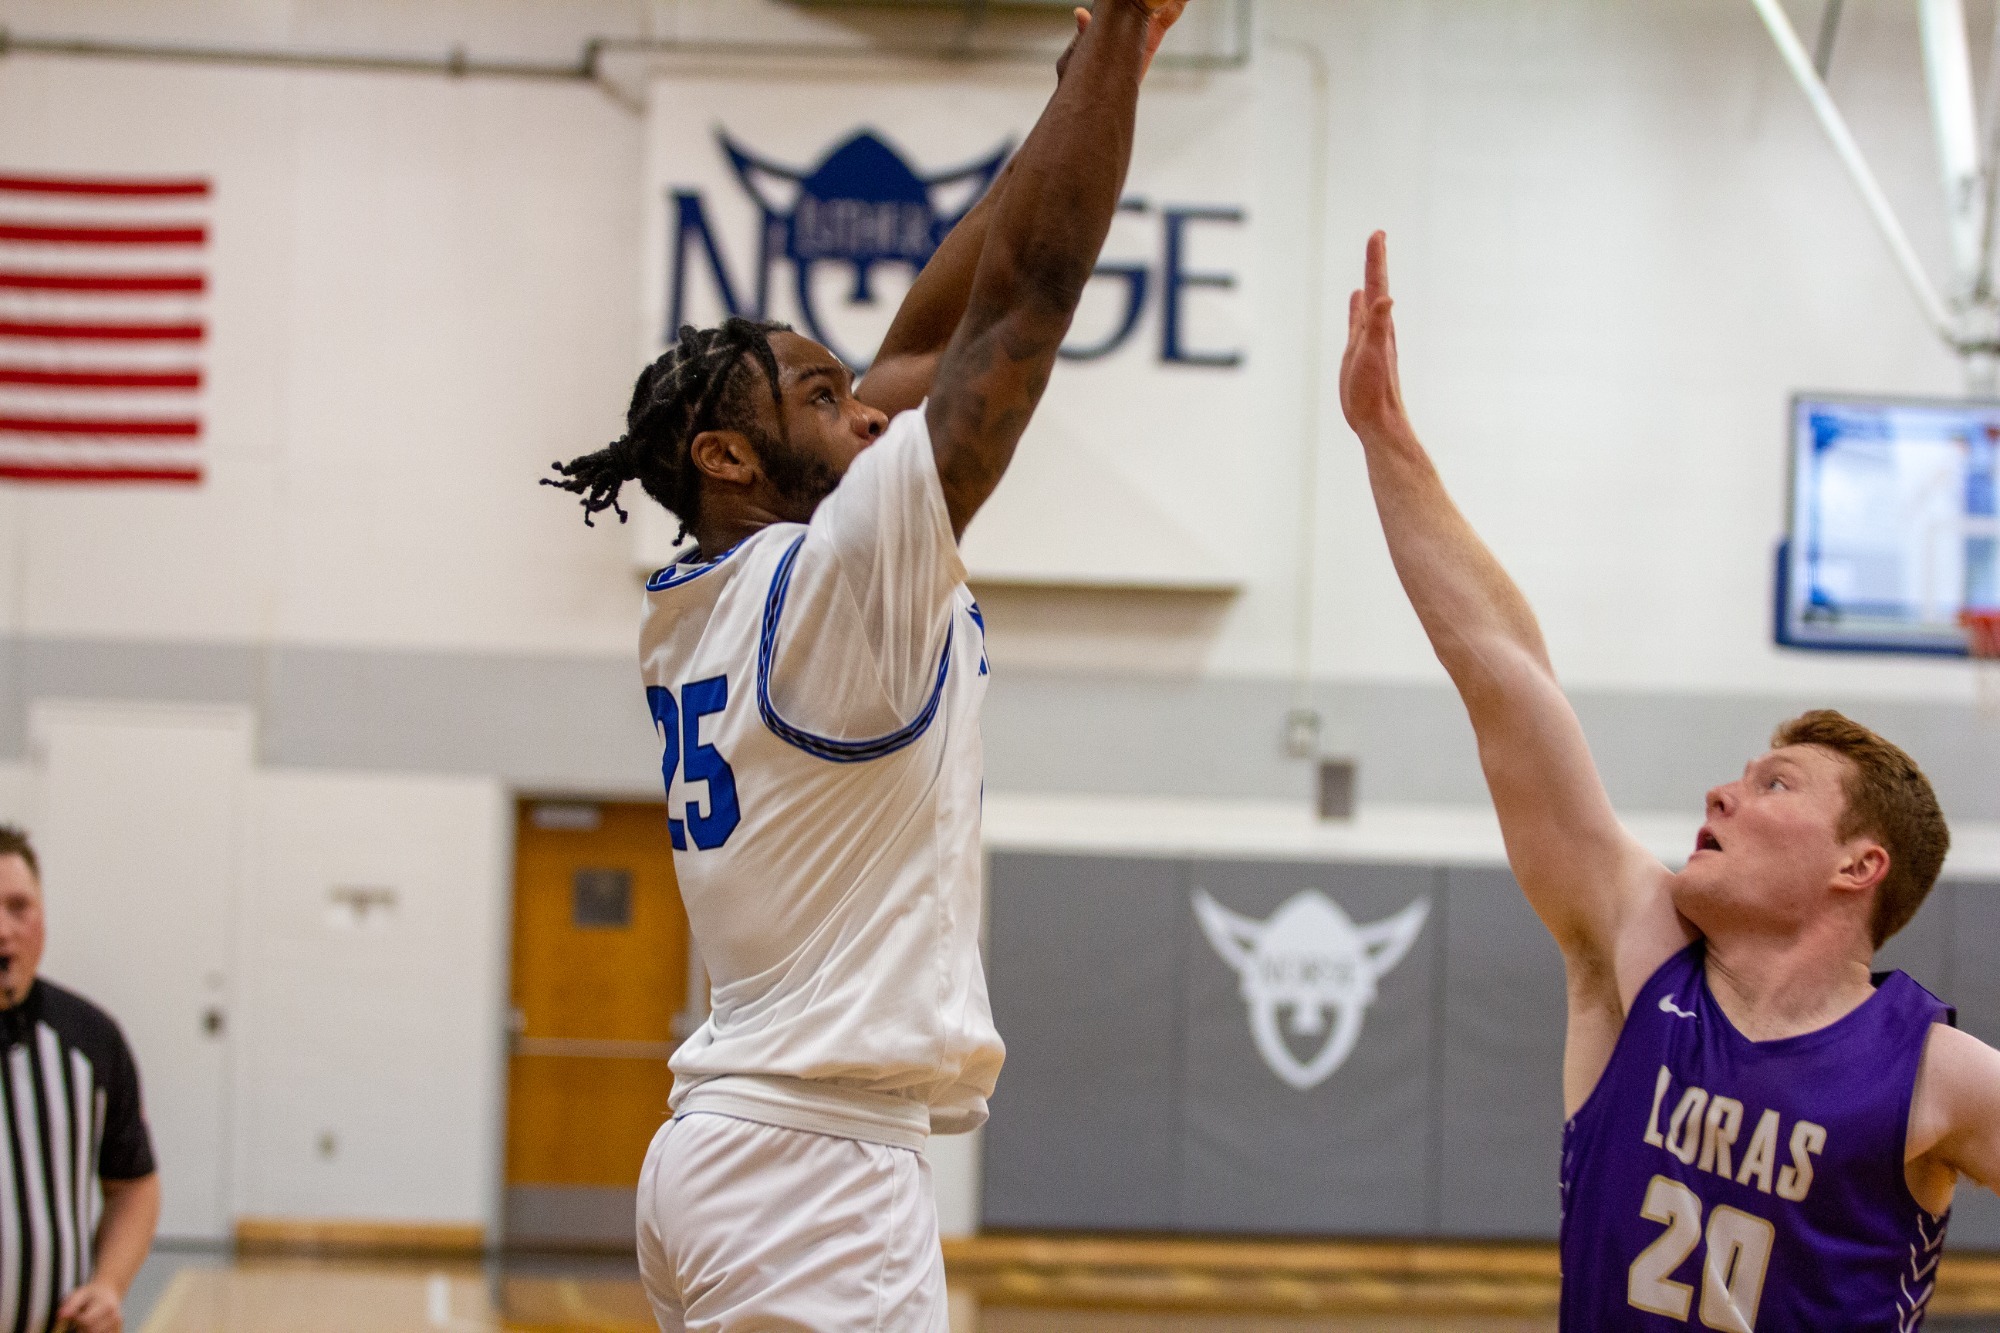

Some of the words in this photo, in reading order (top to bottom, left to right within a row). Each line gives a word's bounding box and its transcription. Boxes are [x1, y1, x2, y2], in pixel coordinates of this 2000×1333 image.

[646, 674, 741, 852] 25
[1643, 1064, 1828, 1202] LORAS
[1627, 1174, 1776, 1333] 20
